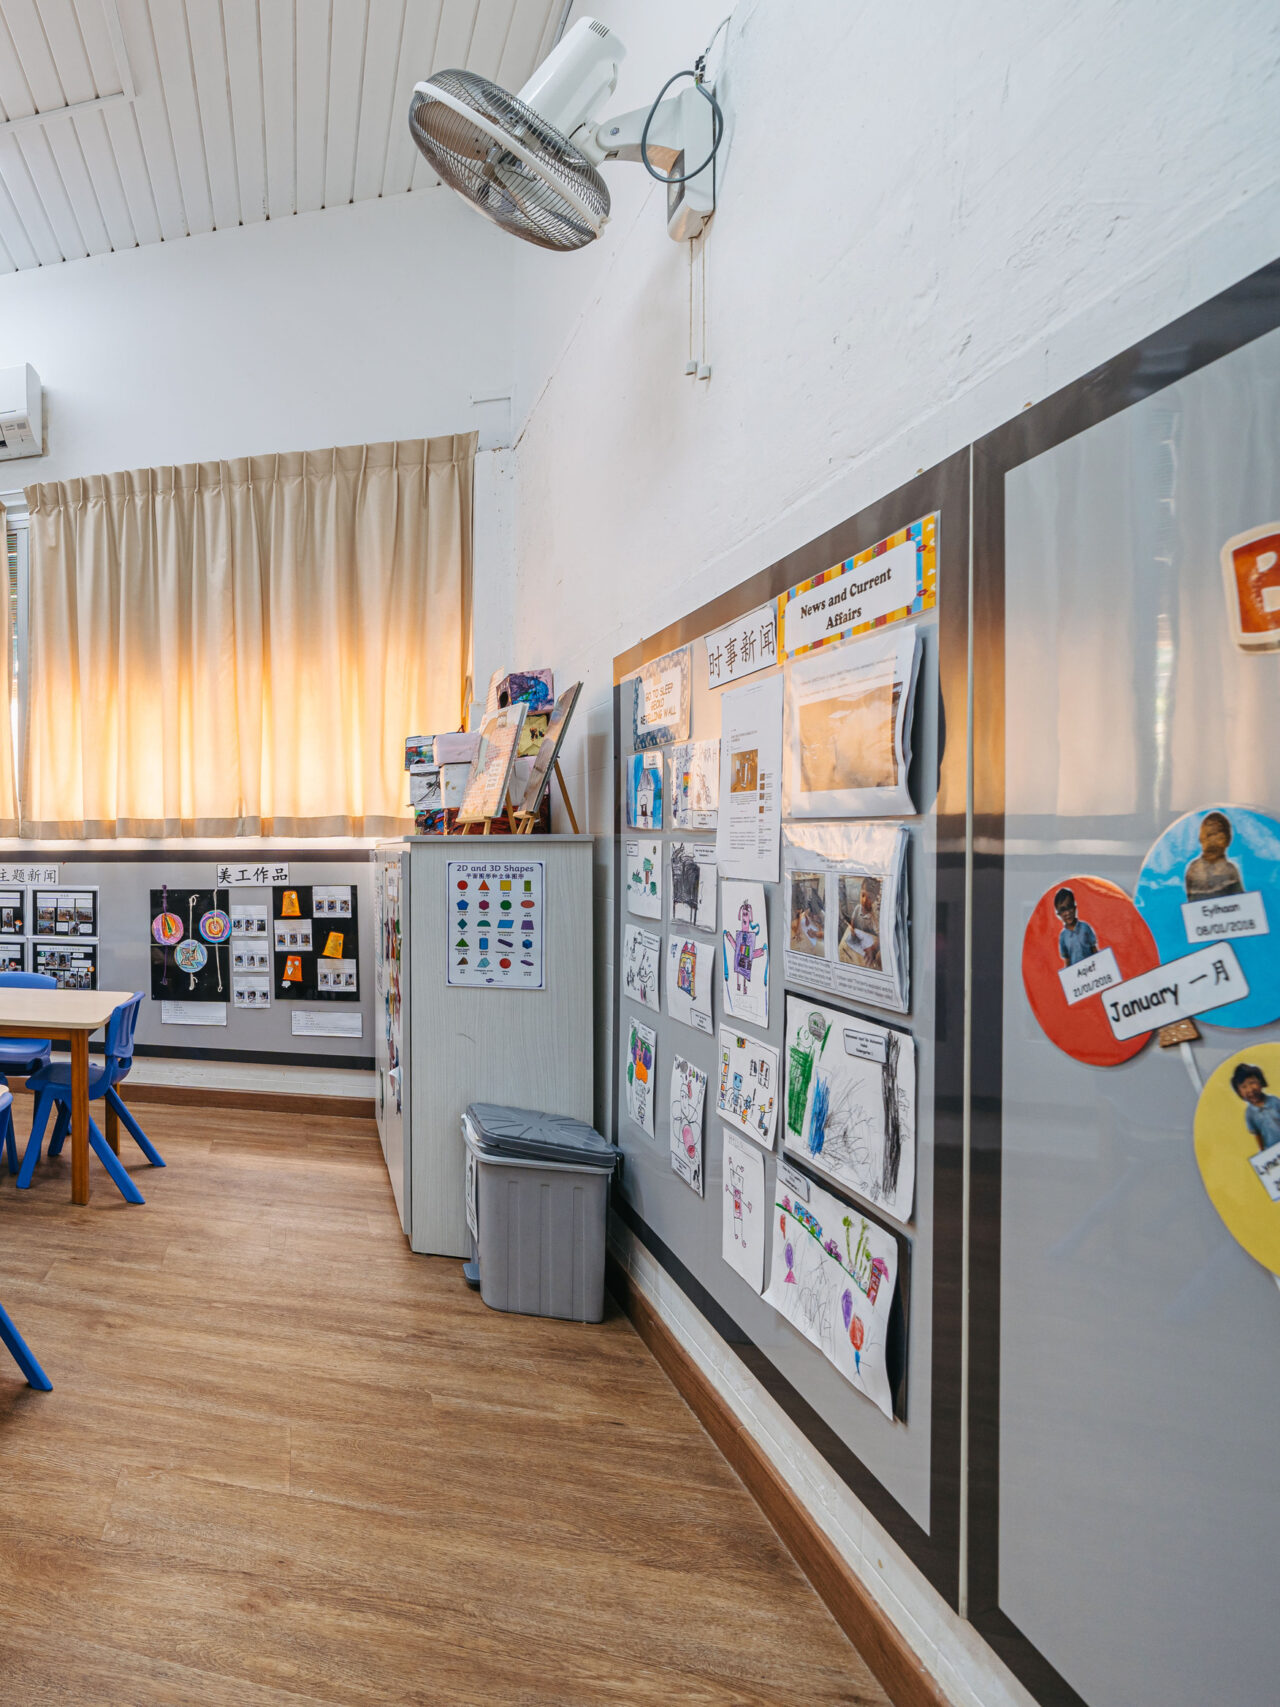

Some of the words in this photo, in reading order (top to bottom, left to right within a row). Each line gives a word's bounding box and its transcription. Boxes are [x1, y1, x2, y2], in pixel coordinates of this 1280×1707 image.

[800, 600, 826, 620] News
[828, 587, 847, 607] and
[849, 567, 892, 597] Current
[826, 607, 862, 631] Affairs
[708, 621, 775, 679] 时事新闻
[218, 866, 288, 884] 美工作品
[504, 865, 534, 873] Shapes
[1196, 920, 1256, 936] 08/01/2018
[1077, 961, 1096, 977] Aqief
[1189, 960, 1230, 985] 一月
[1110, 983, 1179, 1022] January
[1255, 1153, 1280, 1175] Lyne
